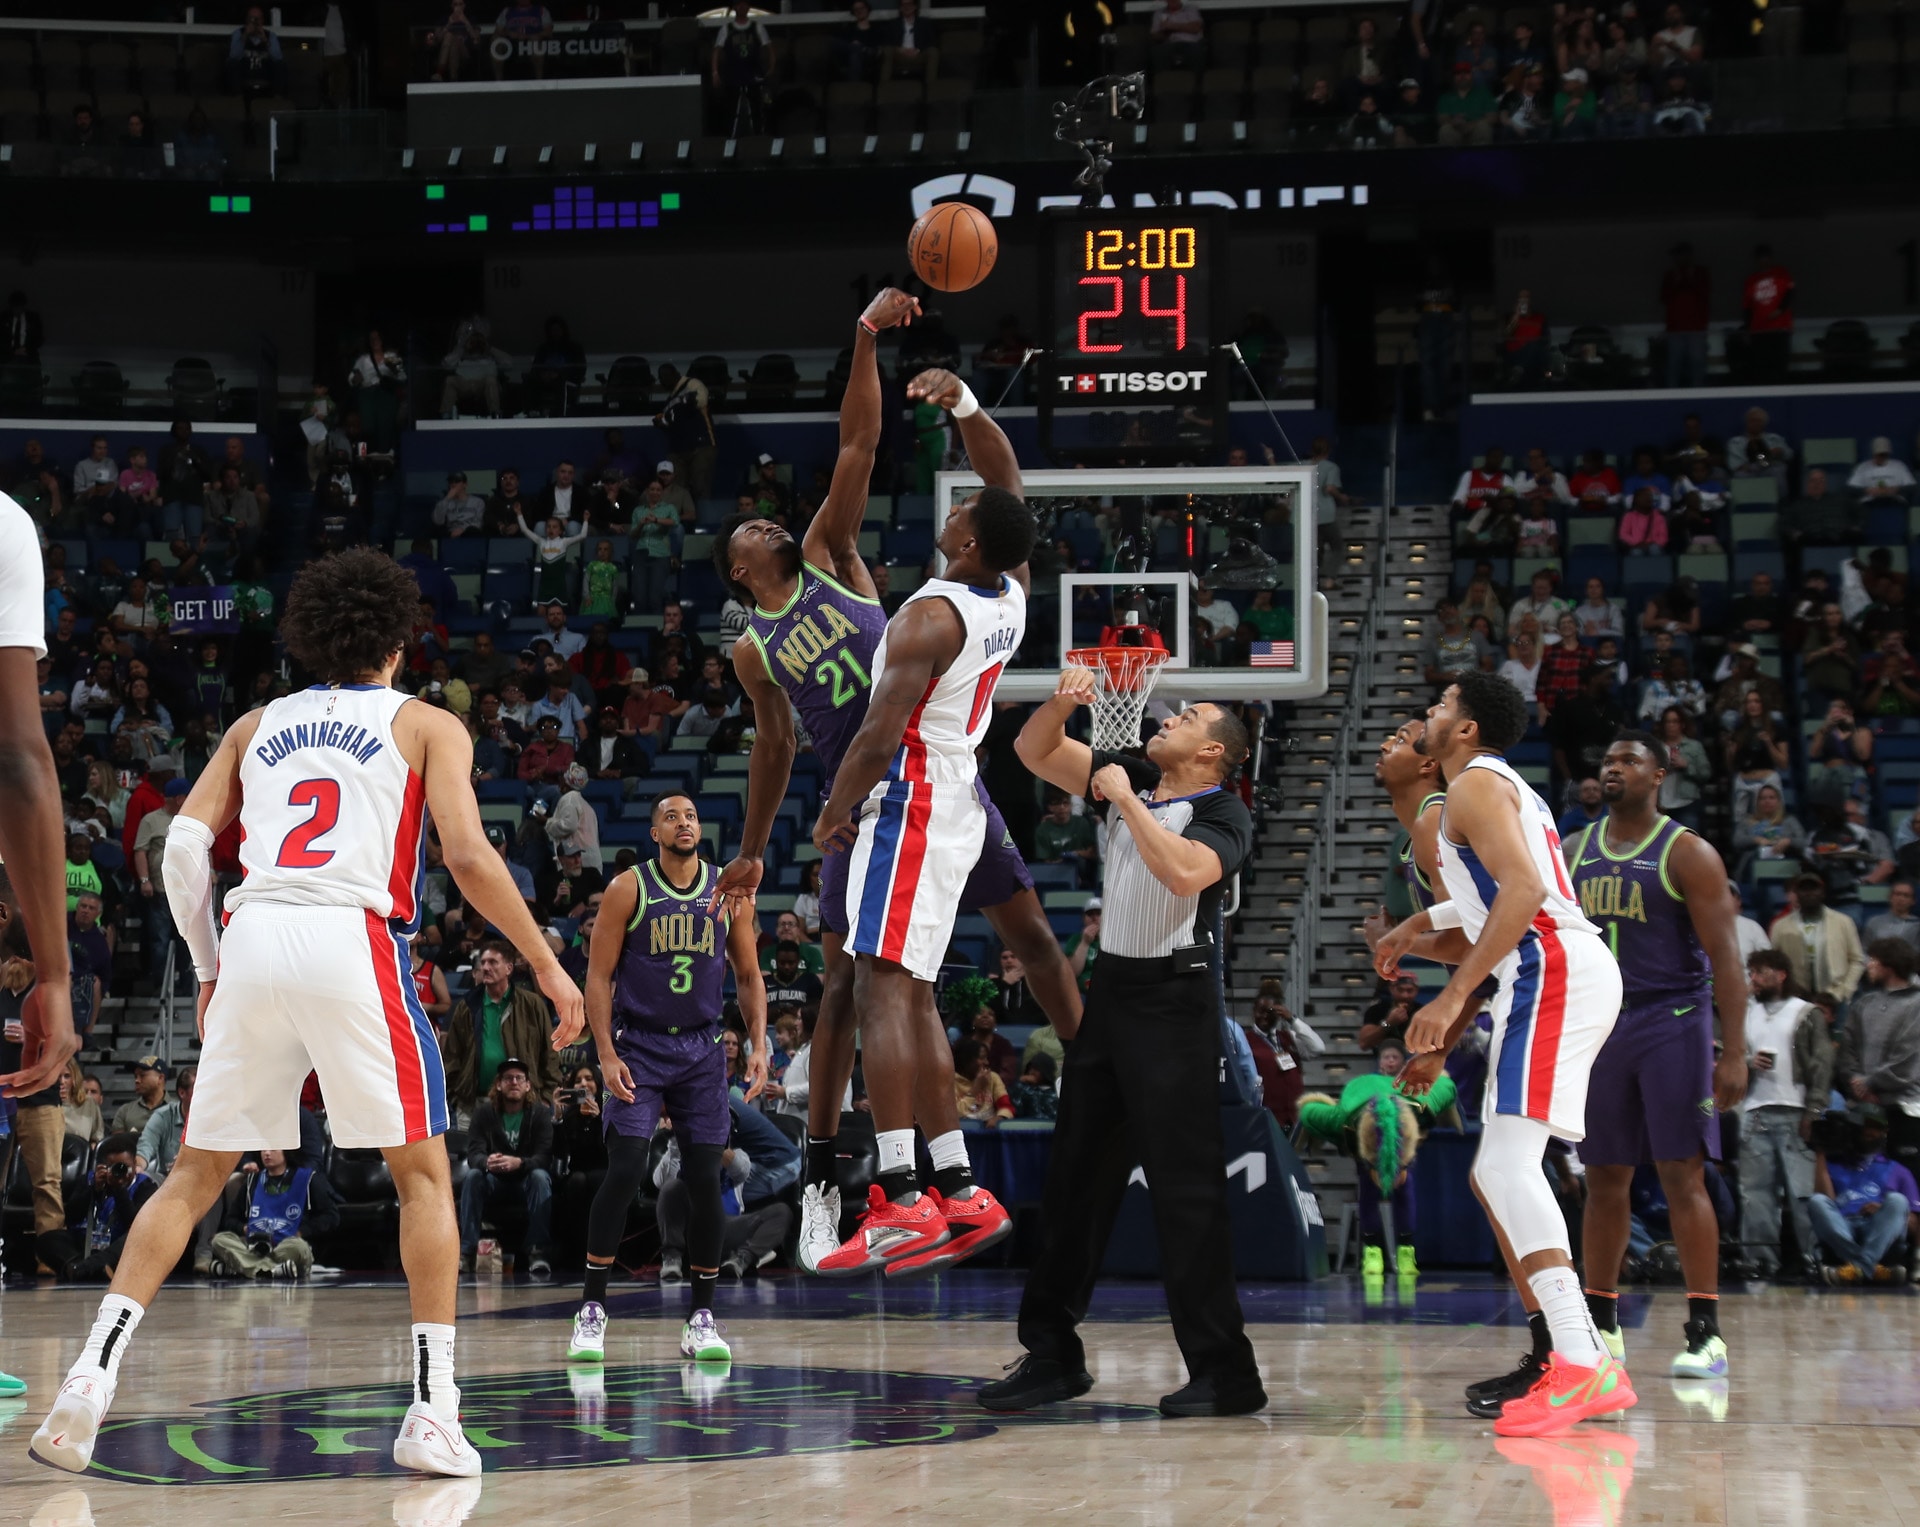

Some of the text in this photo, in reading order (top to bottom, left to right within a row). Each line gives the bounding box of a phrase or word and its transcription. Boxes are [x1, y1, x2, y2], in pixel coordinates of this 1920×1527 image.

[518, 38, 619, 56] HUB CLUB
[1084, 227, 1196, 271] 12:00
[491, 264, 521, 289] 118
[1077, 274, 1188, 353] 24
[1098, 371, 1207, 394] TISSOT
[174, 599, 235, 621] GET UP
[776, 604, 860, 685] NOLA
[984, 627, 1018, 660] DUREN
[815, 646, 872, 709] 21
[966, 661, 1003, 736] 0
[256, 721, 384, 768] CUNNINGHAM
[275, 778, 341, 869] 2
[1581, 875, 1648, 924] NOLA
[650, 913, 715, 957] NOLA
[1606, 921, 1619, 962] 1
[669, 954, 695, 995] 3
[778, 989, 808, 1003] ORLEANS
